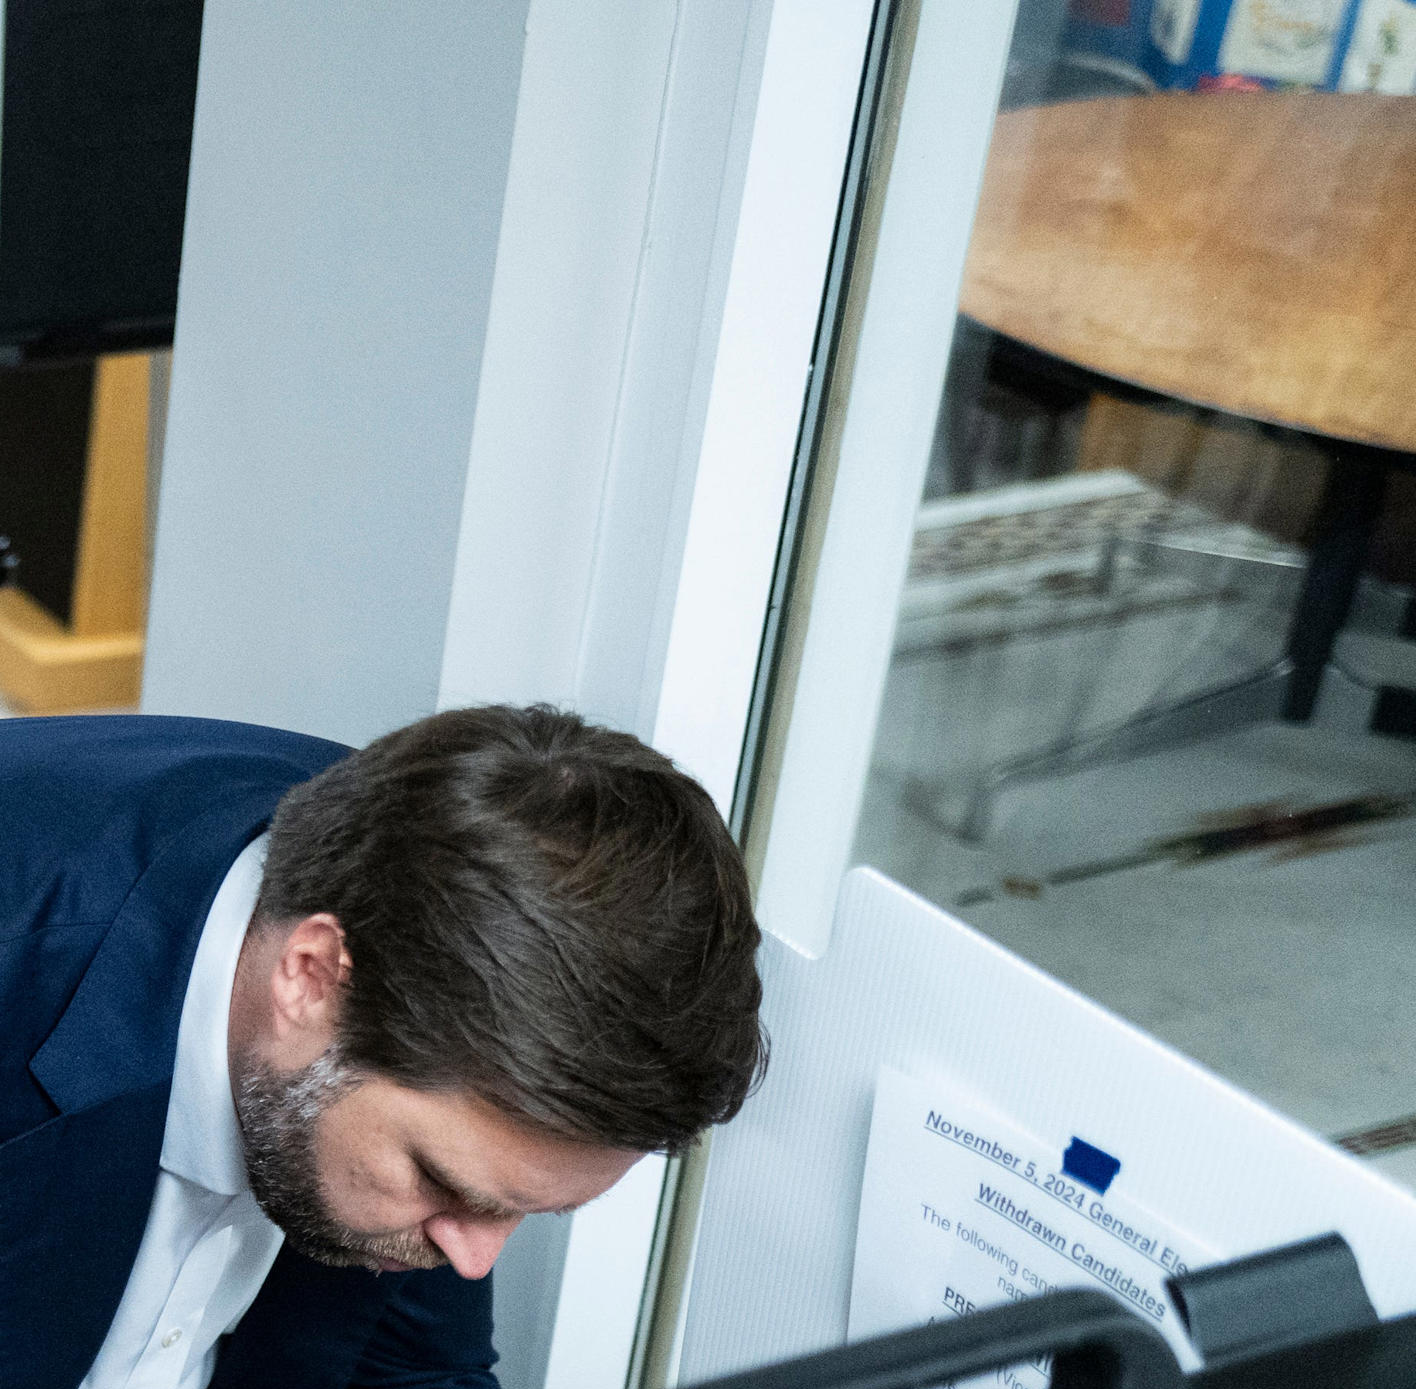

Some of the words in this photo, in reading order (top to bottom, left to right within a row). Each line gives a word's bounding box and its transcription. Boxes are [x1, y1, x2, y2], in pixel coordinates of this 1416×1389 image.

[921, 1203, 951, 1233] The
[956, 1221, 1019, 1275] following
[925, 1110, 1022, 1169] November
[1024, 1161, 1038, 1183] 5,
[1044, 1172, 1085, 1209] 2024
[1088, 1200, 1158, 1256] General
[978, 1182, 1066, 1251] Withdrawn
[1071, 1242, 1166, 1318] Candidates
